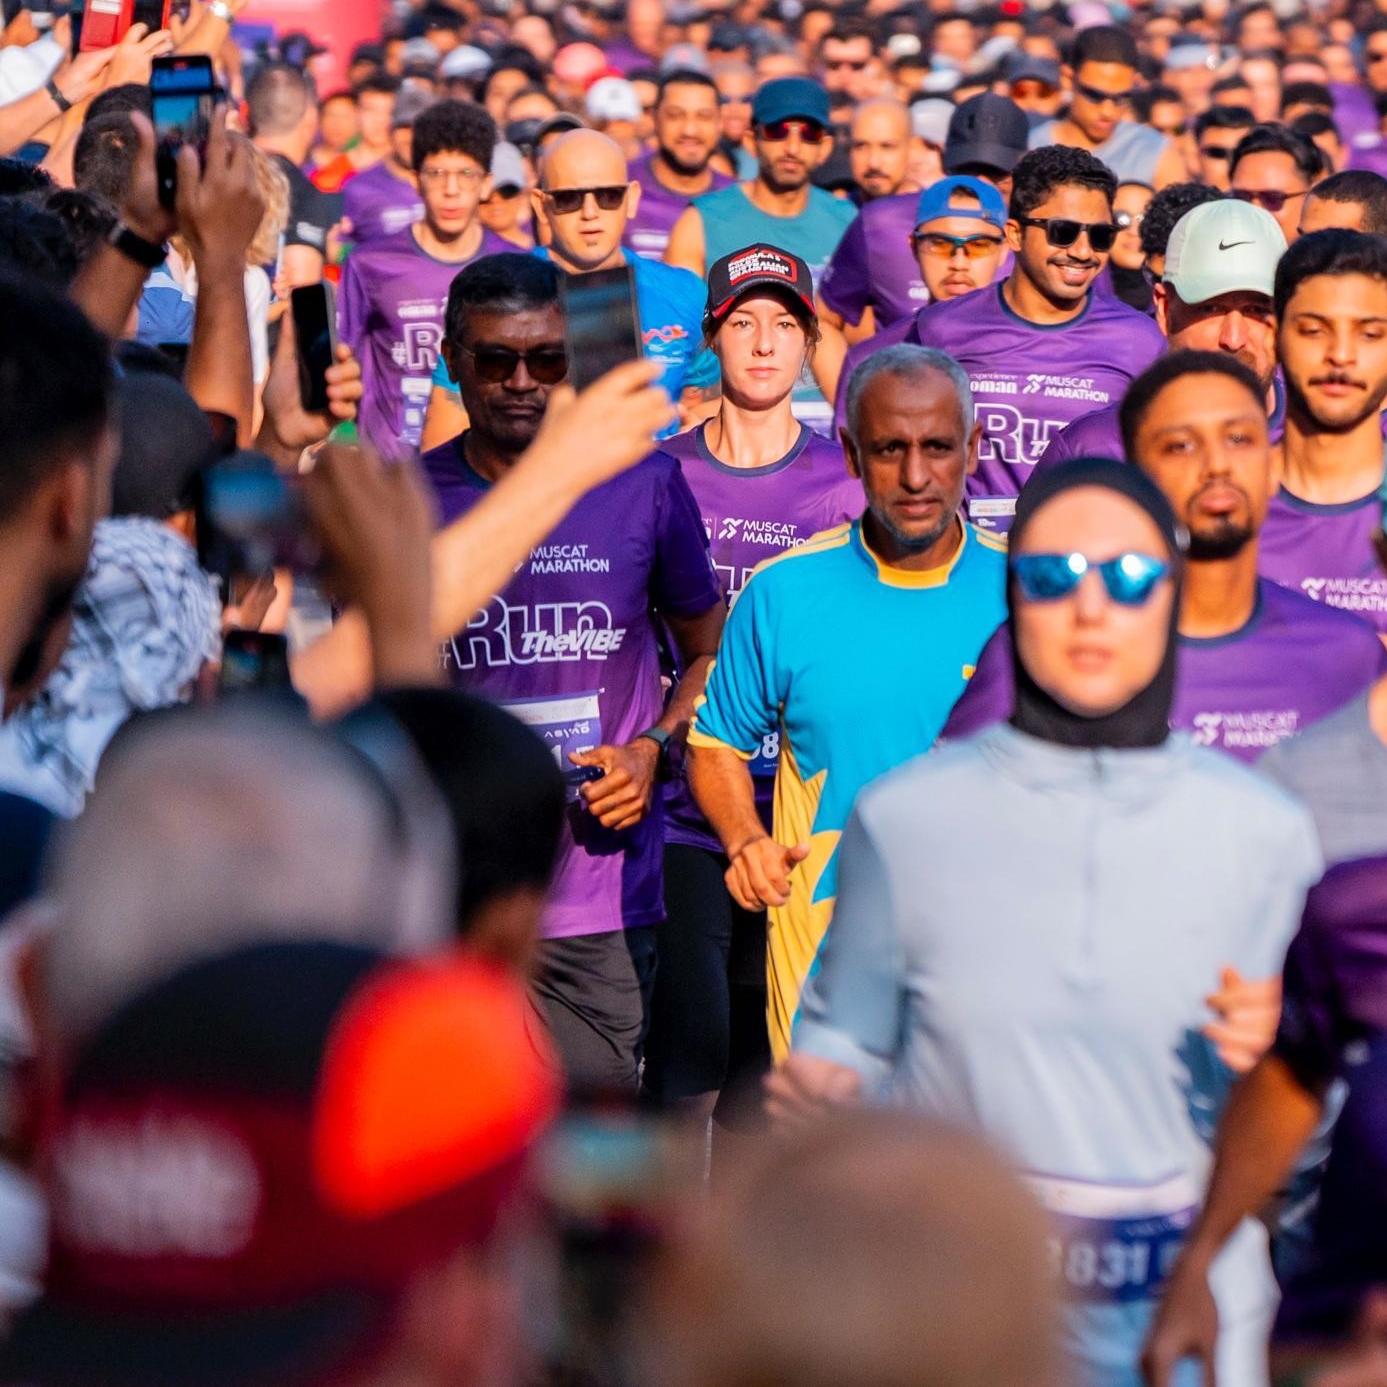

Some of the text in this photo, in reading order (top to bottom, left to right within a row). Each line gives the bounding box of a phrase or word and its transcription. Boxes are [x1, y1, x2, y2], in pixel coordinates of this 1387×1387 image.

[970, 380, 1018, 394] oman
[1045, 375, 1095, 389] MUSCAT
[1044, 386, 1109, 403] MARATHON
[743, 520, 798, 536] MUSCAT
[742, 531, 810, 548] MARATHO
[529, 544, 589, 560] MUSCAT
[531, 558, 610, 575] MARATHON
[521, 628, 627, 655] TheVIBE
